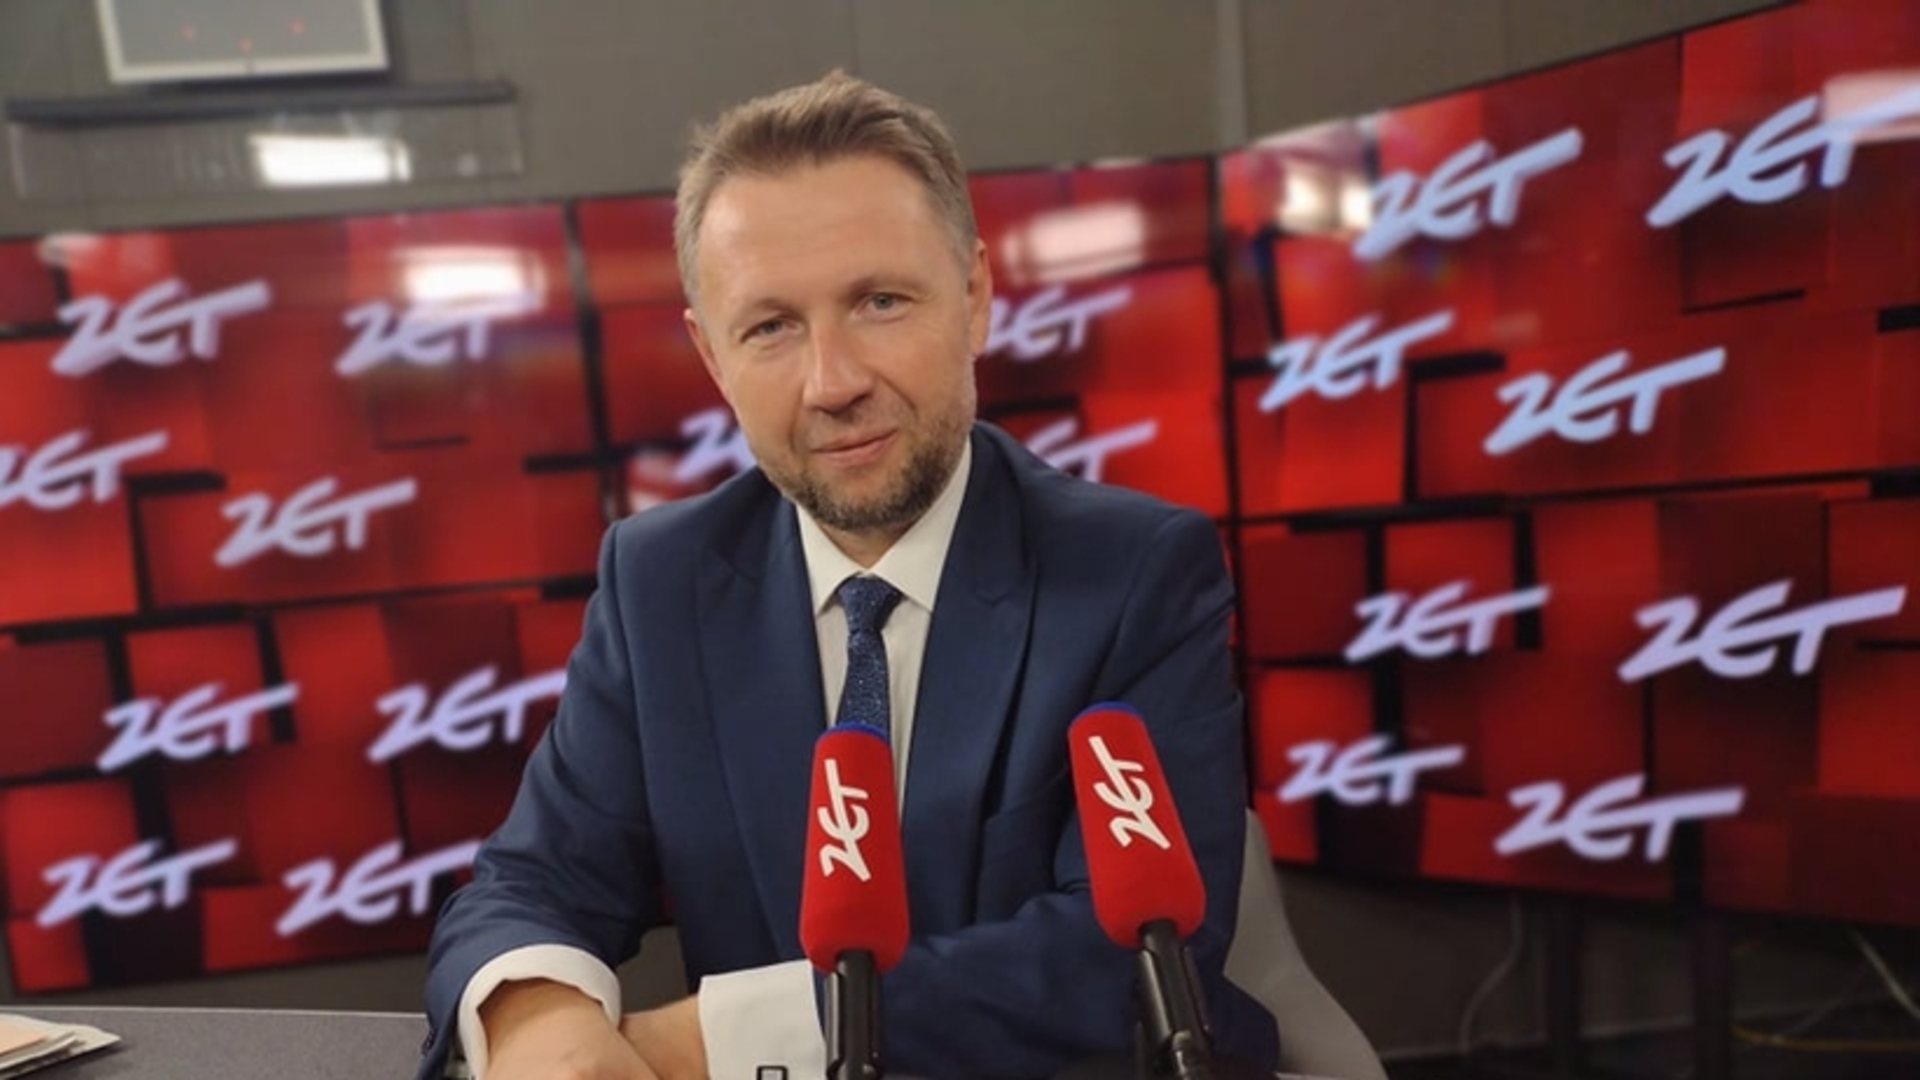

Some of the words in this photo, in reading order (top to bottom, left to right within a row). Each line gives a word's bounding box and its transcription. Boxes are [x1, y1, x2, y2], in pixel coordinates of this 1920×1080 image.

[1353, 128, 1583, 260] ZET
[1646, 84, 1920, 227] ZET
[50, 279, 272, 376] ZET
[334, 294, 542, 376] ZET
[1258, 310, 1455, 412] ZET
[1483, 347, 1726, 455] ZET
[215, 477, 417, 567] ZET
[1344, 580, 1551, 663] ZET
[1617, 579, 1907, 683] ZET
[97, 682, 299, 772] ZET
[367, 666, 570, 764] ZET
[1087, 735, 1171, 850] ZET
[1277, 734, 1465, 806] ZET
[1493, 774, 1745, 863] ZET
[816, 758, 872, 882] ZET
[36, 839, 237, 929] ZET
[275, 840, 483, 937] ZET
